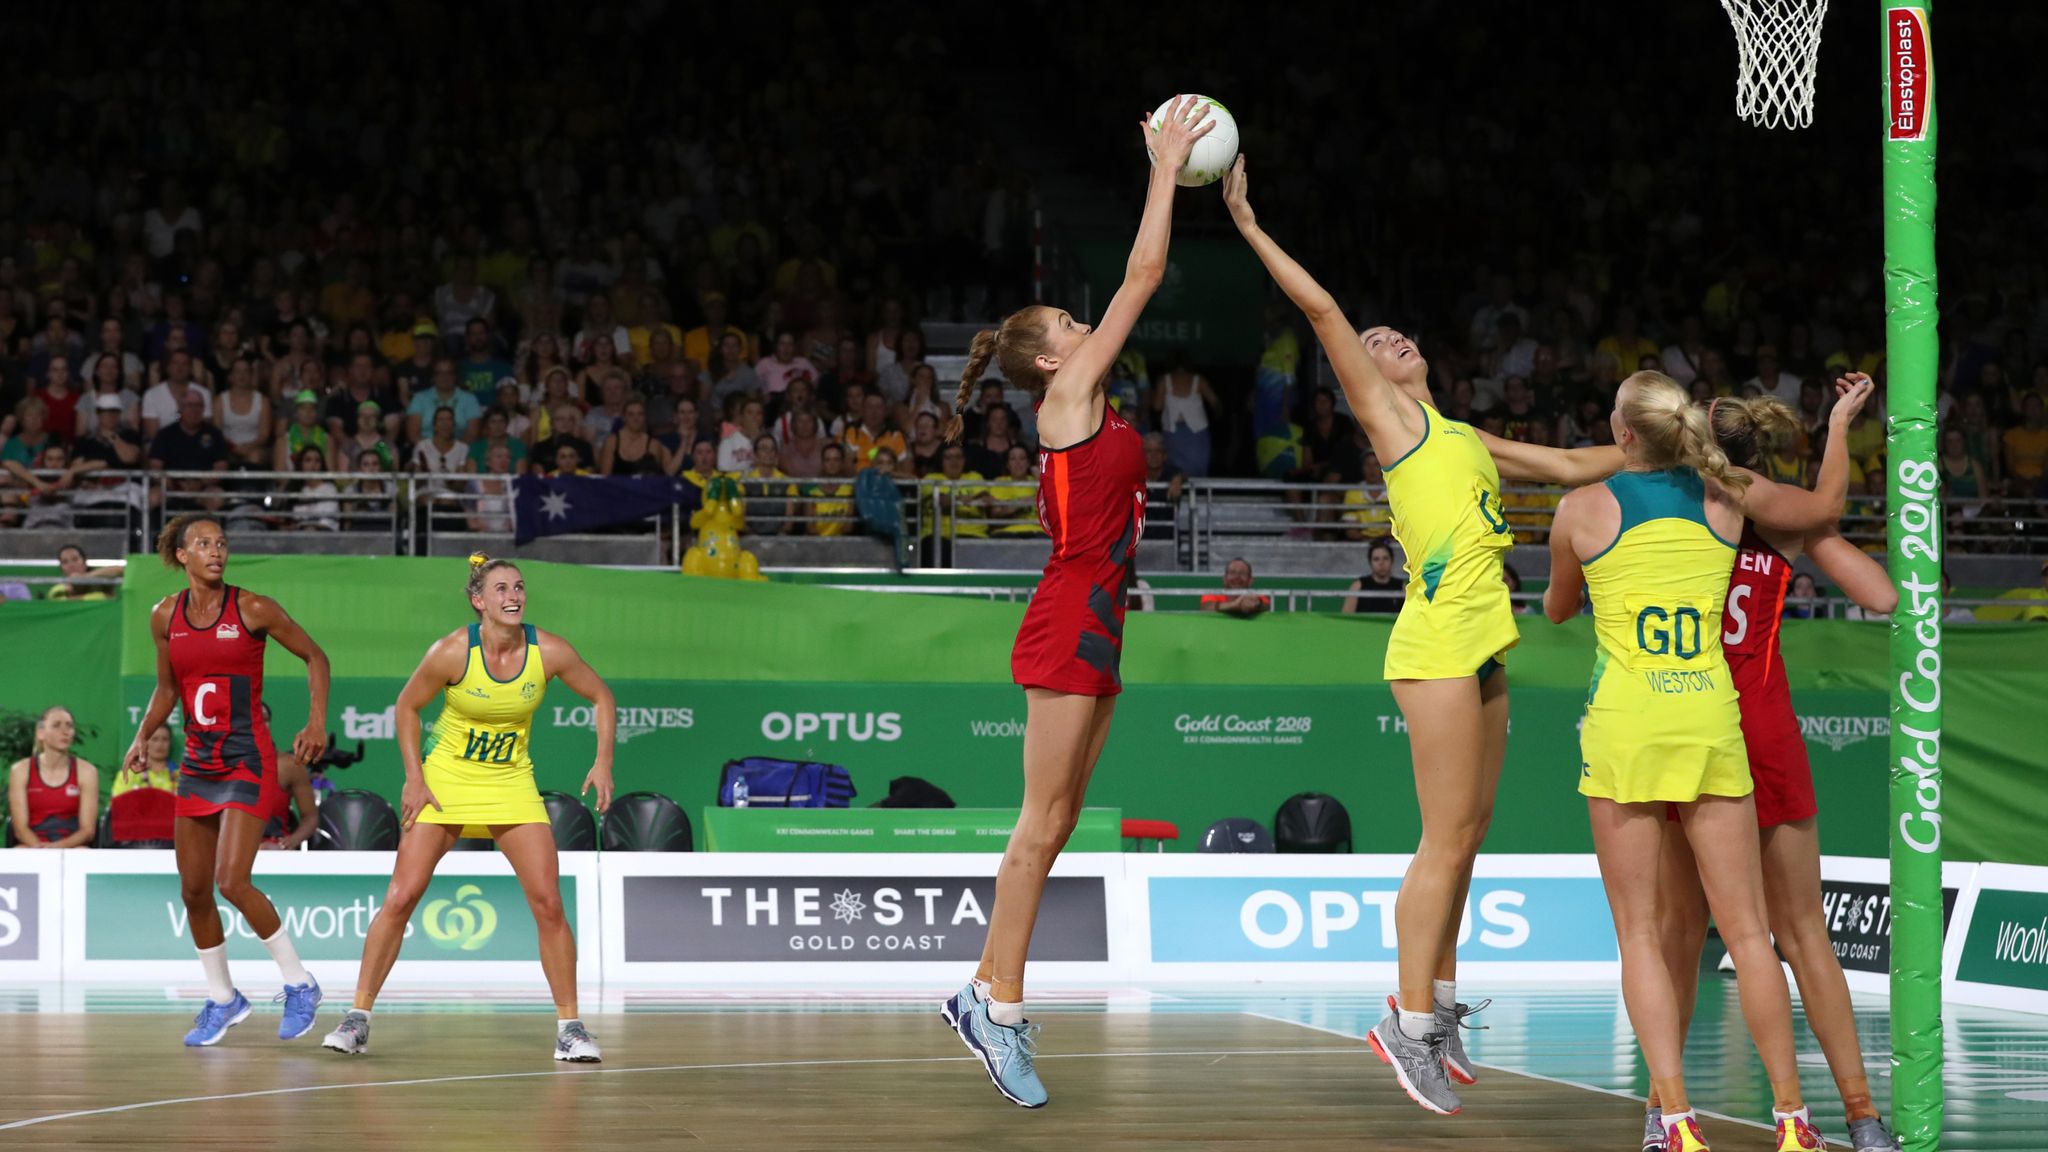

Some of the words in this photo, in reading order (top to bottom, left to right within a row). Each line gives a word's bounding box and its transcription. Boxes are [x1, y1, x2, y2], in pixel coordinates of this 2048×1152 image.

[1896, 19, 1916, 130] Elastoplast
[1898, 458, 1939, 564] 2018
[1723, 583, 1752, 646] S
[1636, 605, 1701, 661] GD
[1900, 570, 1942, 714] Coast
[1646, 670, 1715, 694] WESTON
[127, 706, 180, 725] TE
[194, 682, 217, 727] C
[341, 705, 396, 739] taf
[761, 712, 902, 741] OPTUS
[1174, 714, 1221, 733] Gold
[1223, 714, 1272, 732] Coast
[1275, 716, 1312, 732] 2018
[1200, 735, 1272, 744] COMMONWEALTH
[1274, 735, 1303, 744] GAMES
[463, 728, 519, 763] WD
[1899, 721, 1943, 855] Gold
[850, 828, 874, 836] GAMES
[917, 828, 930, 836] THE
[931, 828, 956, 836] DREAM
[701, 887, 822, 926] THE
[873, 887, 988, 926] STA
[1240, 889, 1530, 949] OPTS
[1822, 892, 1851, 932] HE
[789, 935, 855, 951] GOLD
[866, 935, 946, 951] COAST
[1831, 941, 1848, 957] OLD
[1850, 943, 1880, 960] COAST
